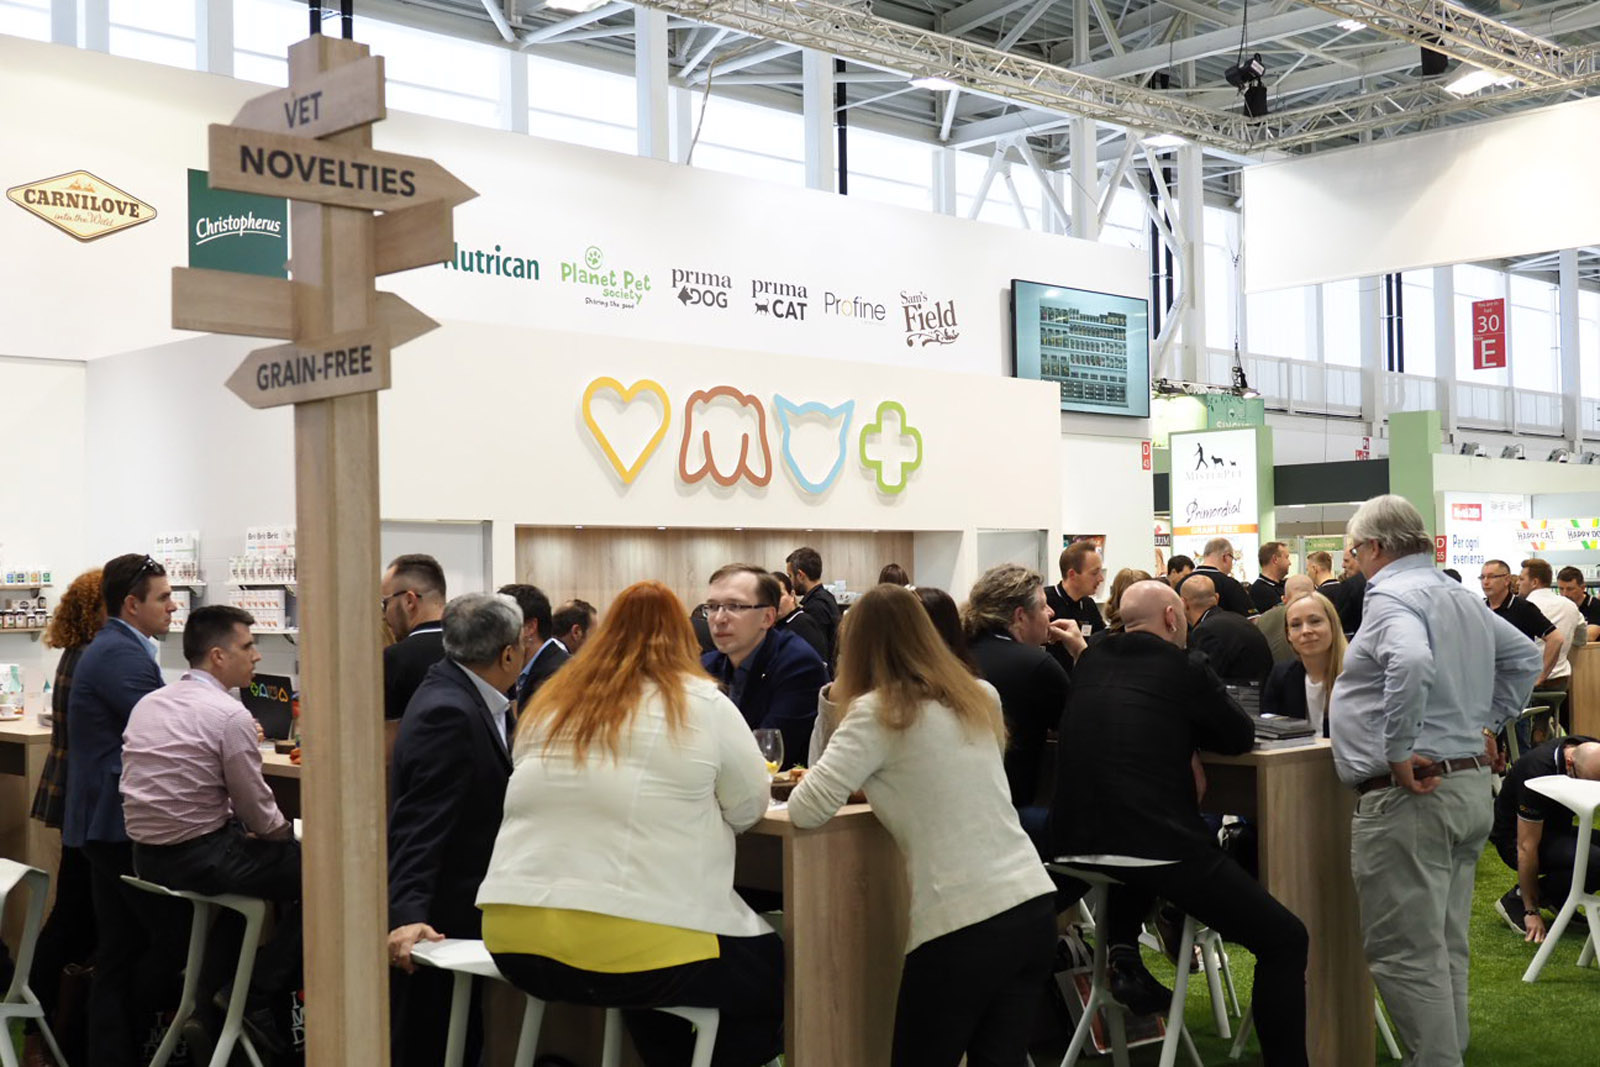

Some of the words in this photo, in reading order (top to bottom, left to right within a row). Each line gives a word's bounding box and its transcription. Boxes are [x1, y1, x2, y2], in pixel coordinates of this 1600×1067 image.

[284, 91, 322, 128] VET
[240, 145, 415, 197] NOVELTIES
[23, 188, 139, 218] CARNILOVE
[73, 212, 88, 223] the
[87, 212, 114, 226] Wild
[196, 211, 281, 237] Christopherus
[561, 261, 617, 287] Planet
[623, 270, 652, 291] Pet
[671, 268, 732, 289] prima
[690, 287, 728, 308] DOG
[751, 278, 808, 299] prima
[900, 290, 928, 304] Sam's
[772, 299, 808, 320] CAT
[824, 291, 886, 321] Profine
[902, 299, 958, 333] Field
[1477, 314, 1500, 333] 30
[1481, 339, 1497, 367] E
[256, 345, 373, 391] GRAIN-FREE
[1142, 443, 1150, 455] D
[1186, 498, 1242, 523] Primordial
[1436, 537, 1445, 548] D
[1453, 534, 1464, 548] Per
[1540, 531, 1554, 540] CAT
[1591, 529, 1600, 538] DO
[1437, 551, 1445, 561] 55
